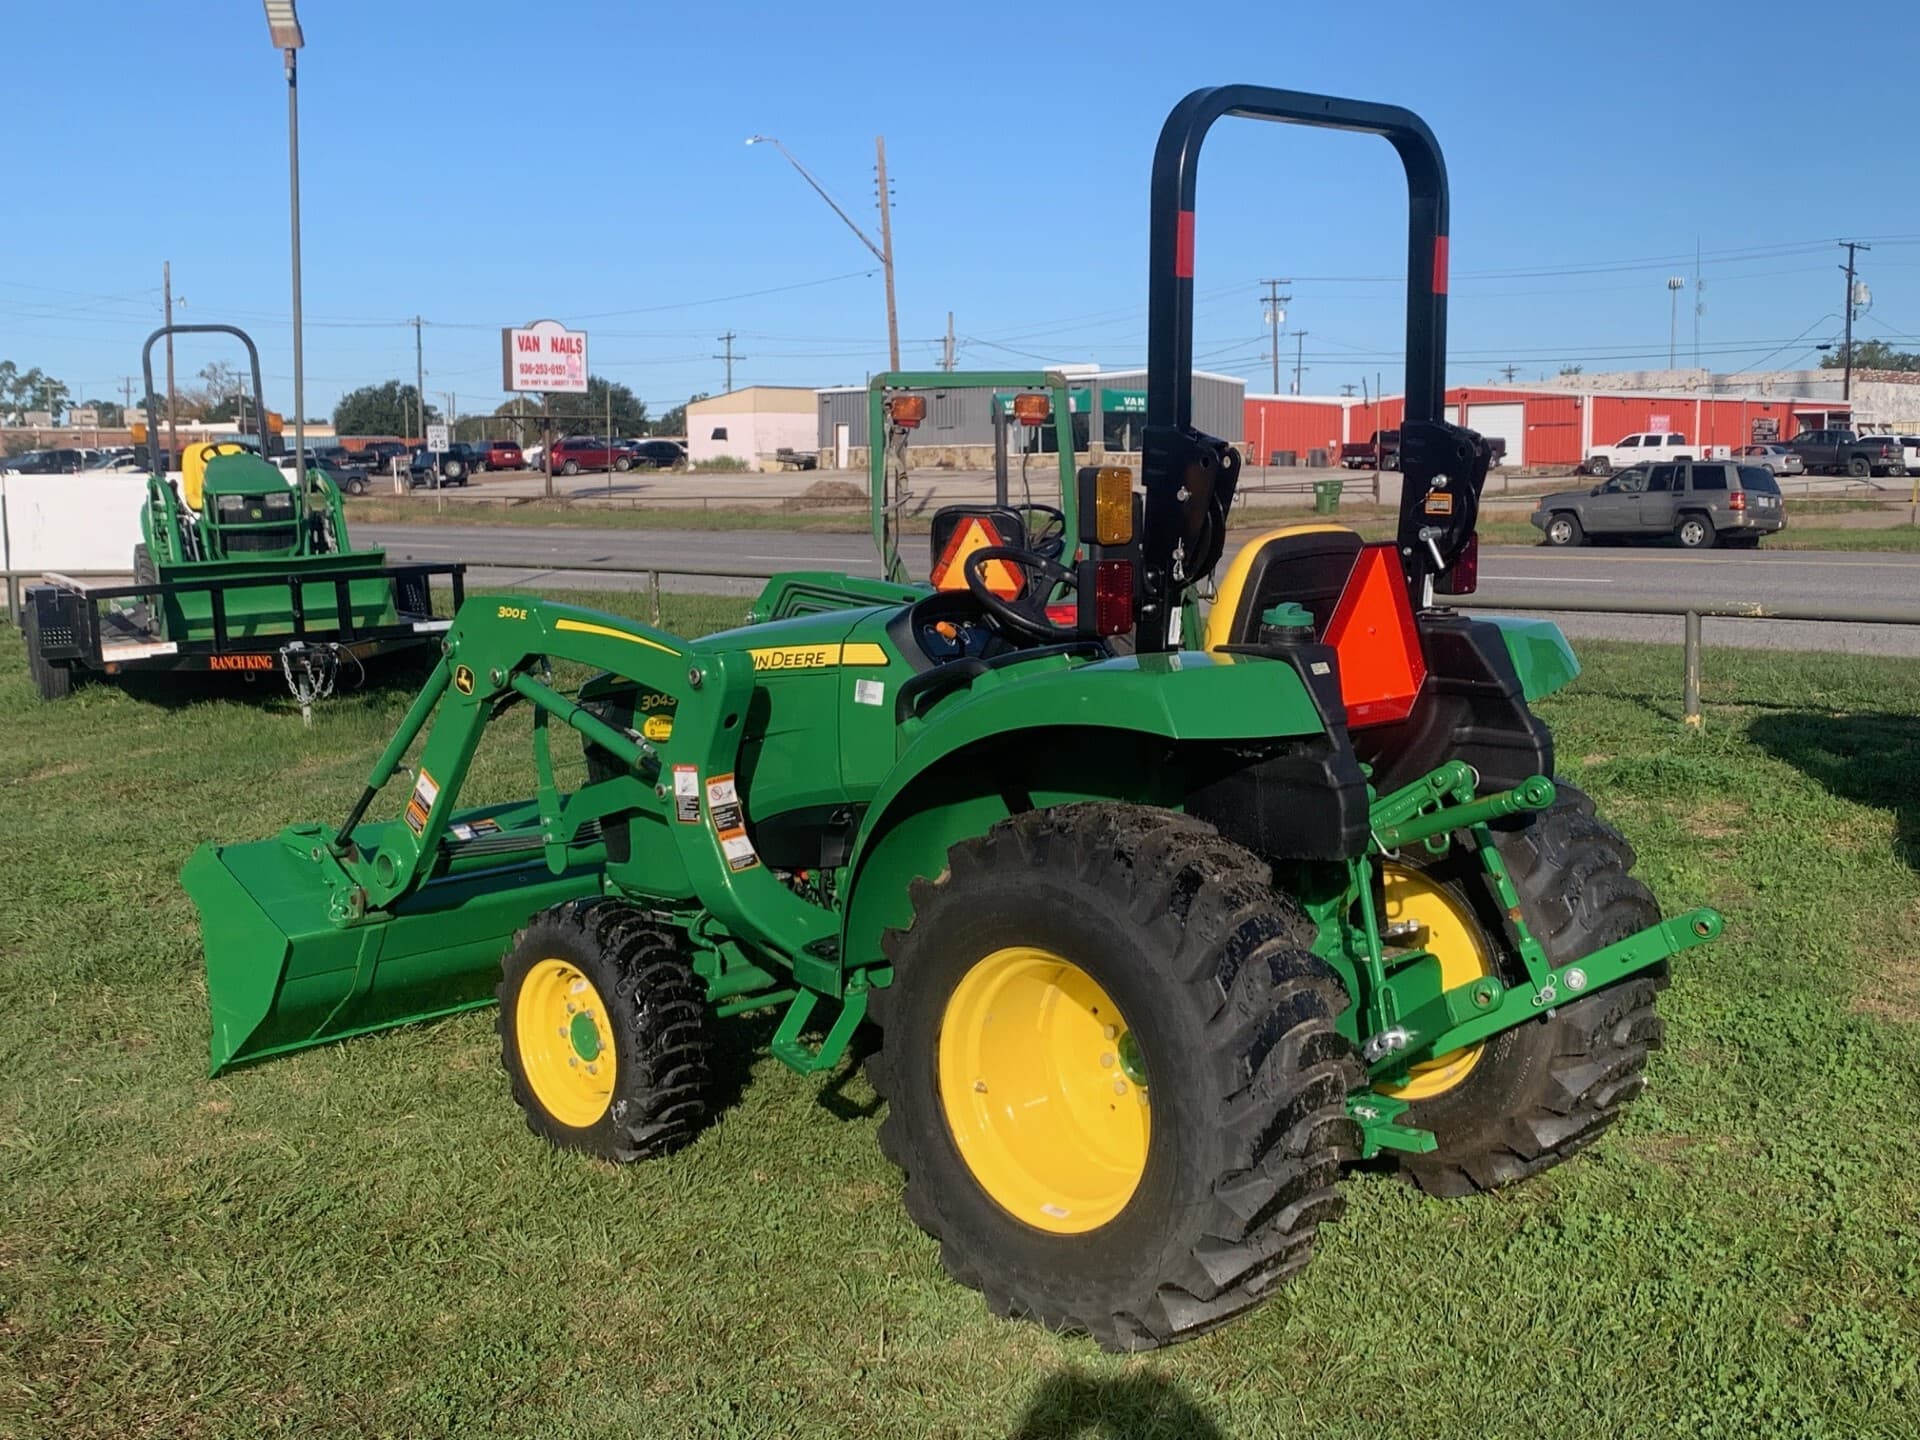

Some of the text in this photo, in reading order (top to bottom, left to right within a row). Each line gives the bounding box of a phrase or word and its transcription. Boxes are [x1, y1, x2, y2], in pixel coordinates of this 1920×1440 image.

[517, 335, 583, 354] VAN NAILS
[1123, 396, 1145, 407] VAN
[430, 439, 447, 449] 45
[210, 655, 273, 670] RANCH KING
[771, 652, 826, 667] DEERE
